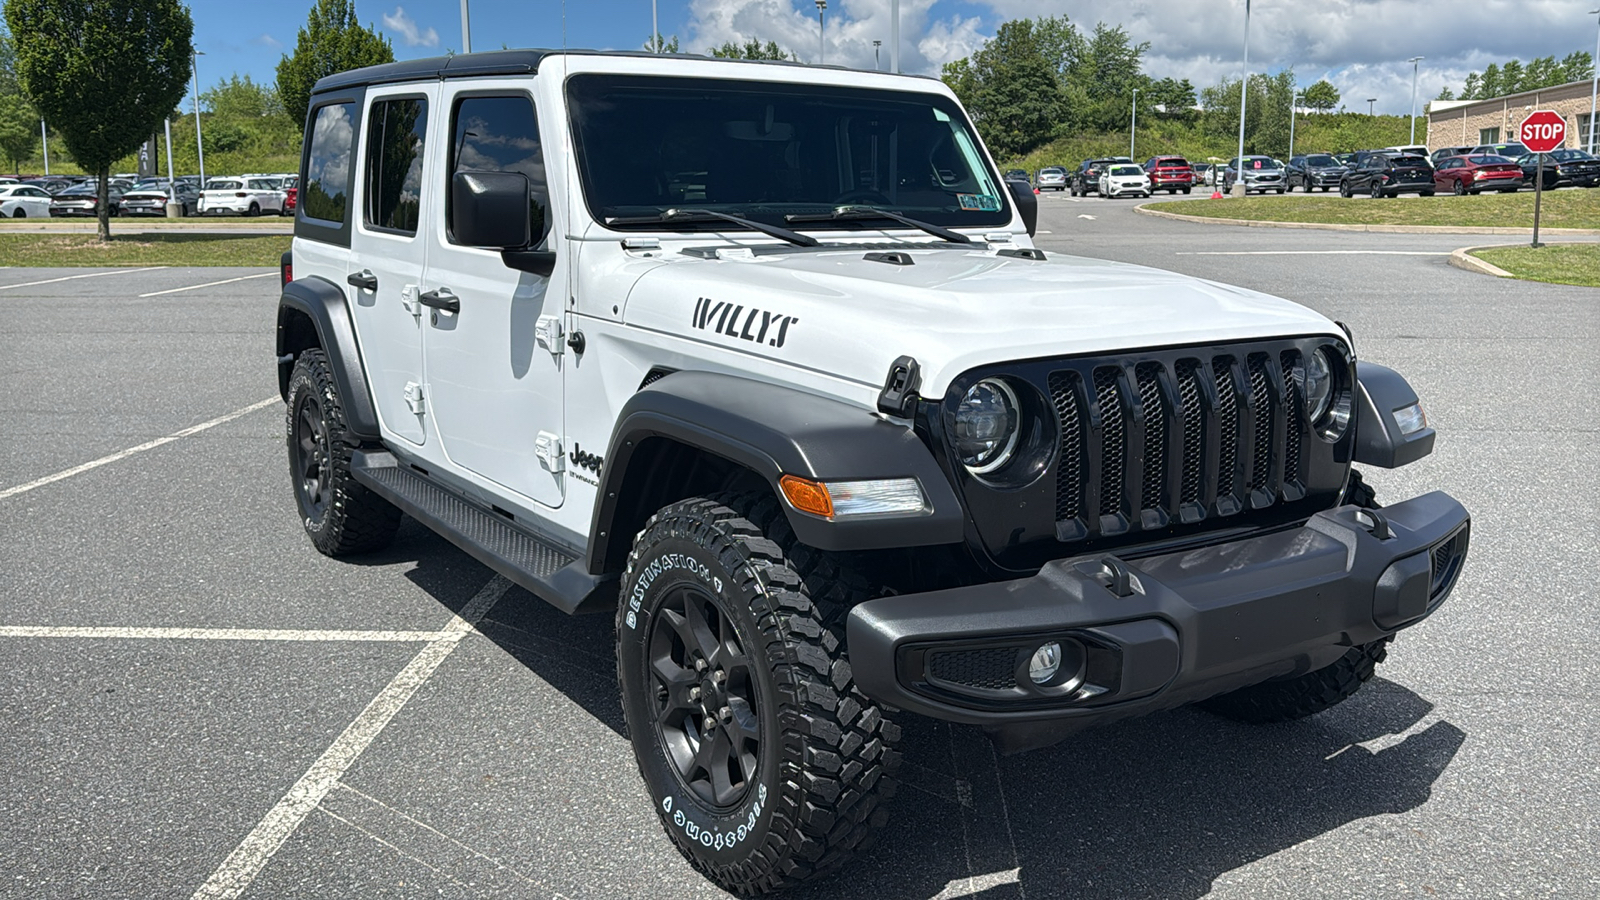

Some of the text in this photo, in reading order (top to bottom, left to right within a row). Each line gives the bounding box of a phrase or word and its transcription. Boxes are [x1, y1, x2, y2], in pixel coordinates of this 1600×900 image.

[1523, 123, 1563, 140] STOP
[692, 297, 799, 348] WILLYS
[569, 441, 604, 478] Jeep
[626, 554, 711, 630] DESTINATION
